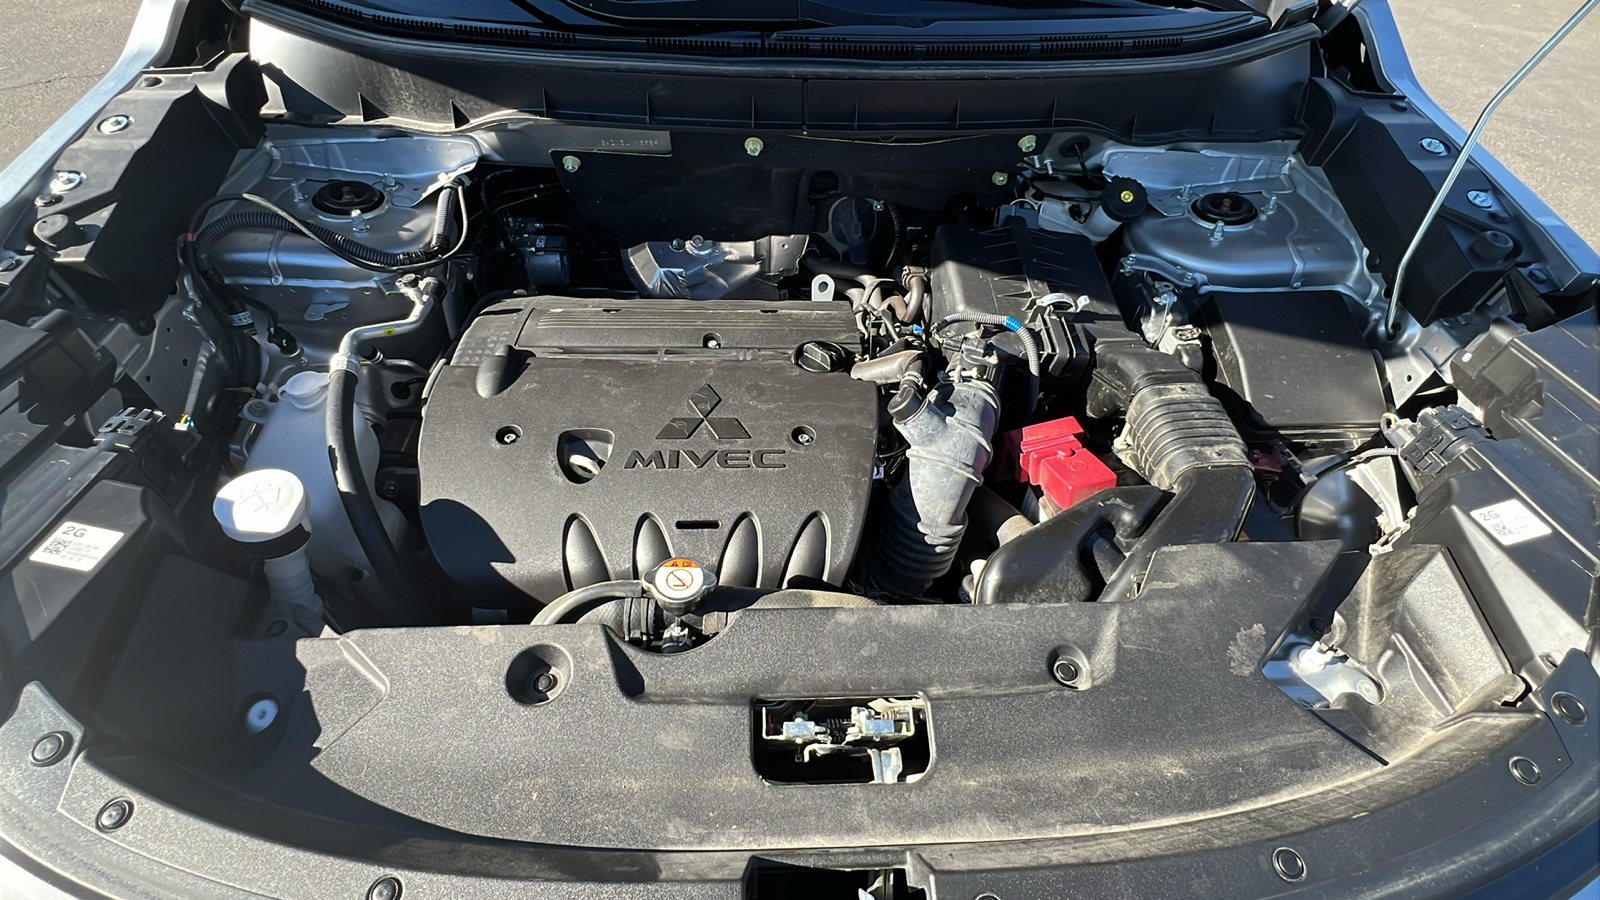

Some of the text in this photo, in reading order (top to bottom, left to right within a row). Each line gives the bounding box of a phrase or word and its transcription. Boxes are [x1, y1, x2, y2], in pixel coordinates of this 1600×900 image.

[623, 449, 787, 469] MIVEC
[1478, 510, 1501, 522] 2G
[61, 525, 88, 538] 2G
